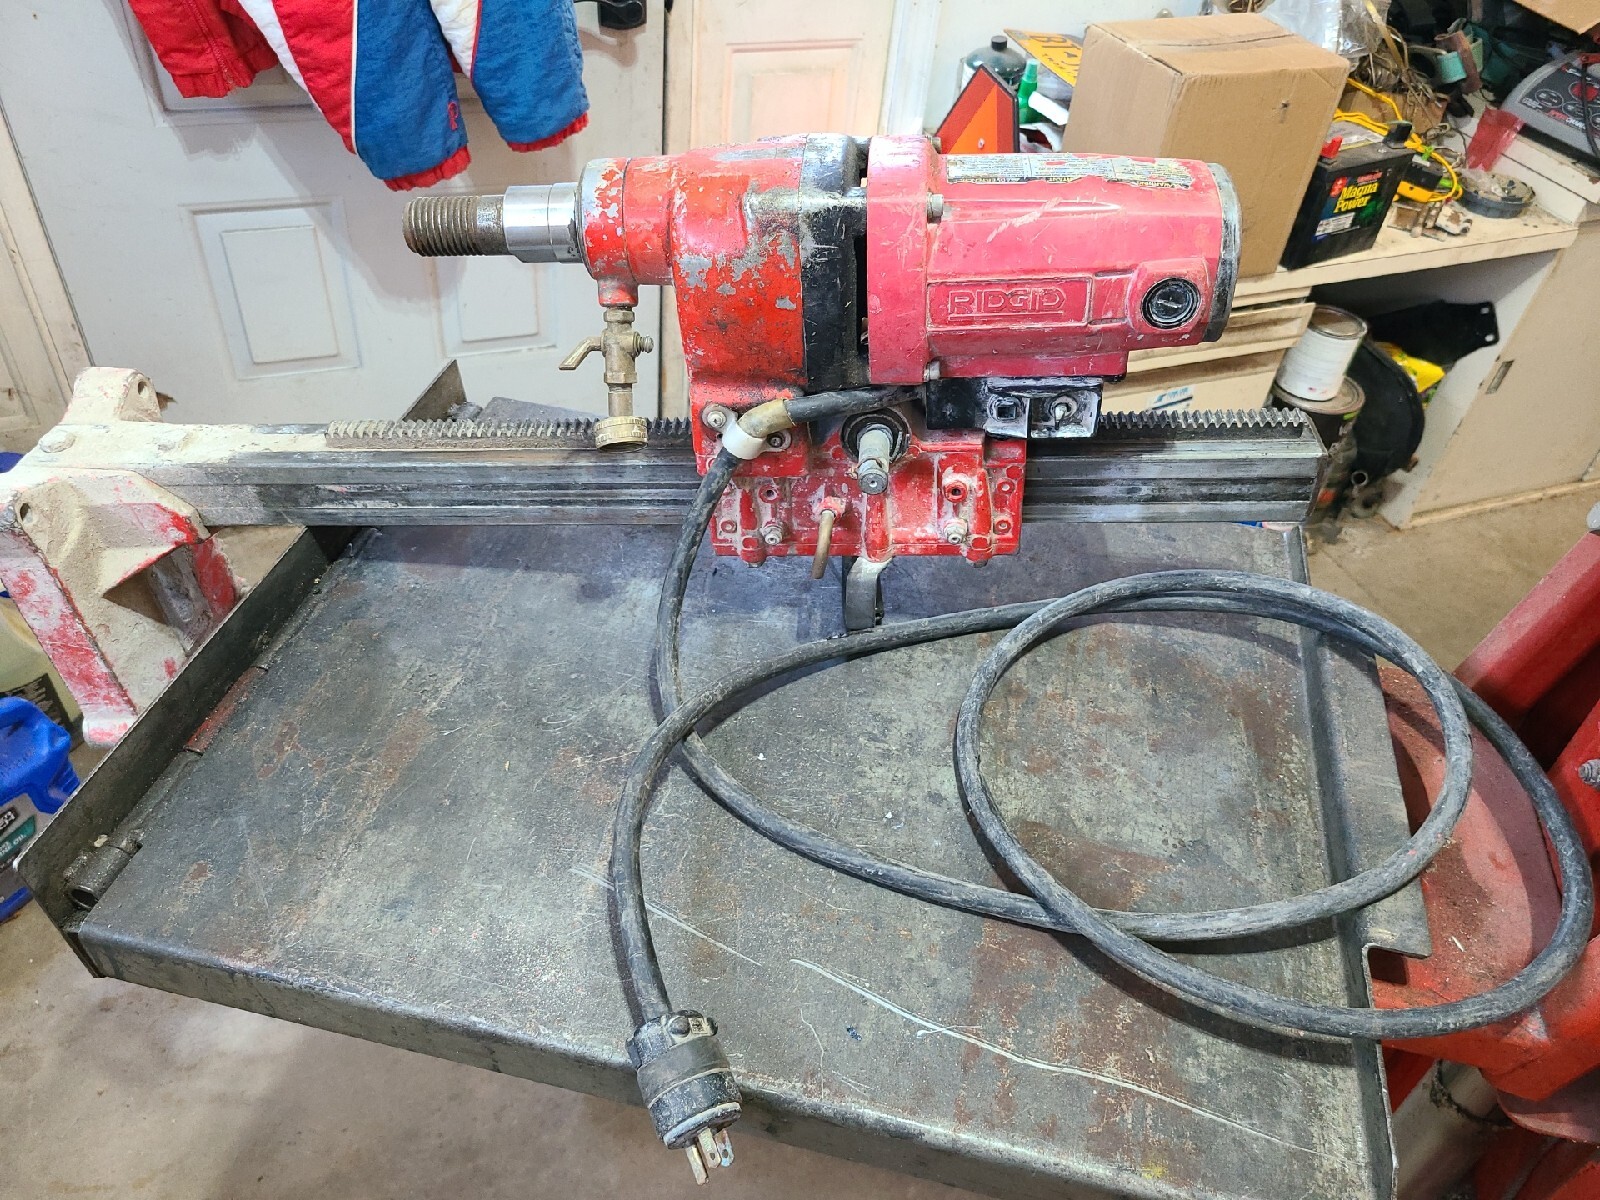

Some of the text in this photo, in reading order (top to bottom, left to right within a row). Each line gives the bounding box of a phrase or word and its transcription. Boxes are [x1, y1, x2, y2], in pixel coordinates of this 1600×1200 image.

[1339, 182, 1379, 200] Magna
[1334, 195, 1371, 213] Power
[947, 288, 1066, 315] RIDGID
